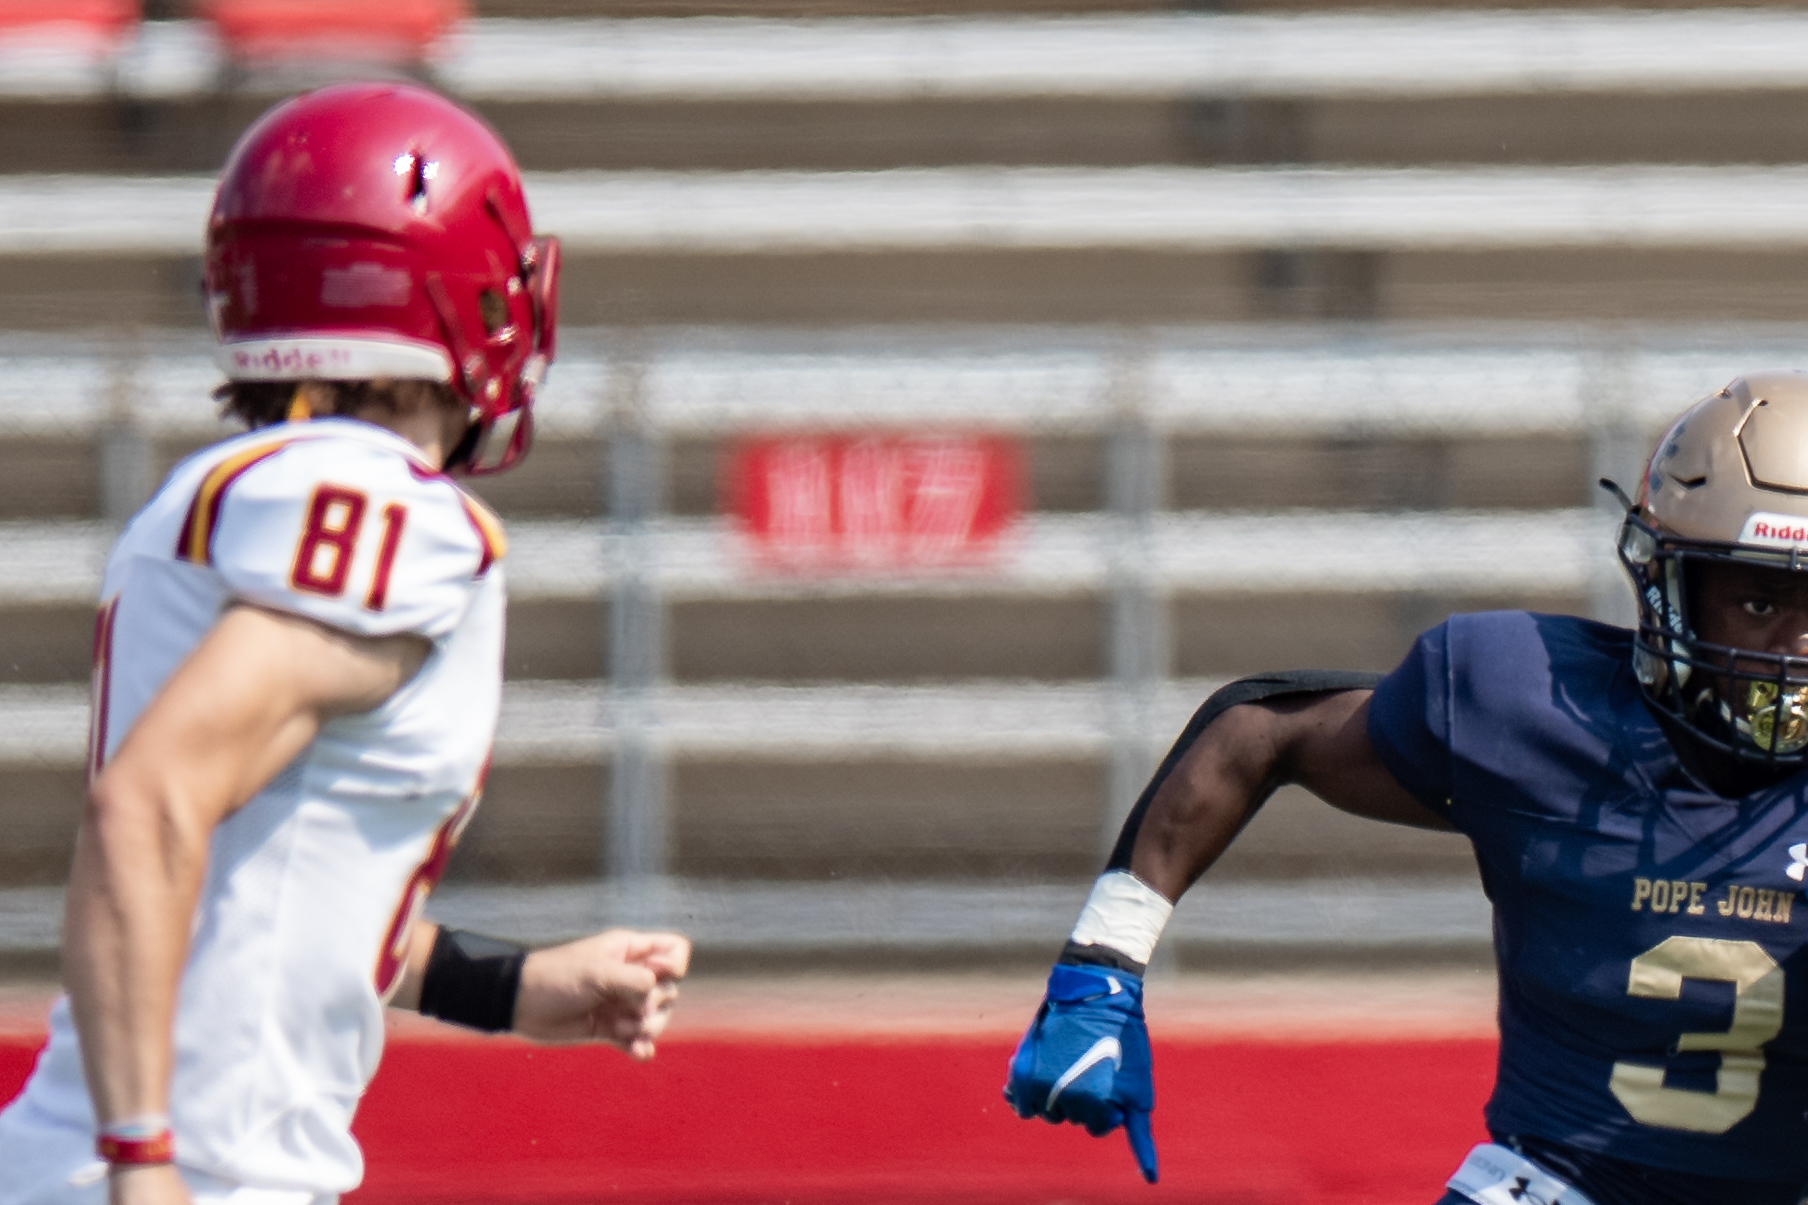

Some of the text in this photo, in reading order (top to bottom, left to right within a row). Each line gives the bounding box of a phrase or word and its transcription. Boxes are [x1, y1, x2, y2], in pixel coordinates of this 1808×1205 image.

[289, 480, 408, 615] 81
[1630, 877, 1796, 924] POPE JOHN
[1608, 935, 1786, 1136] 3
